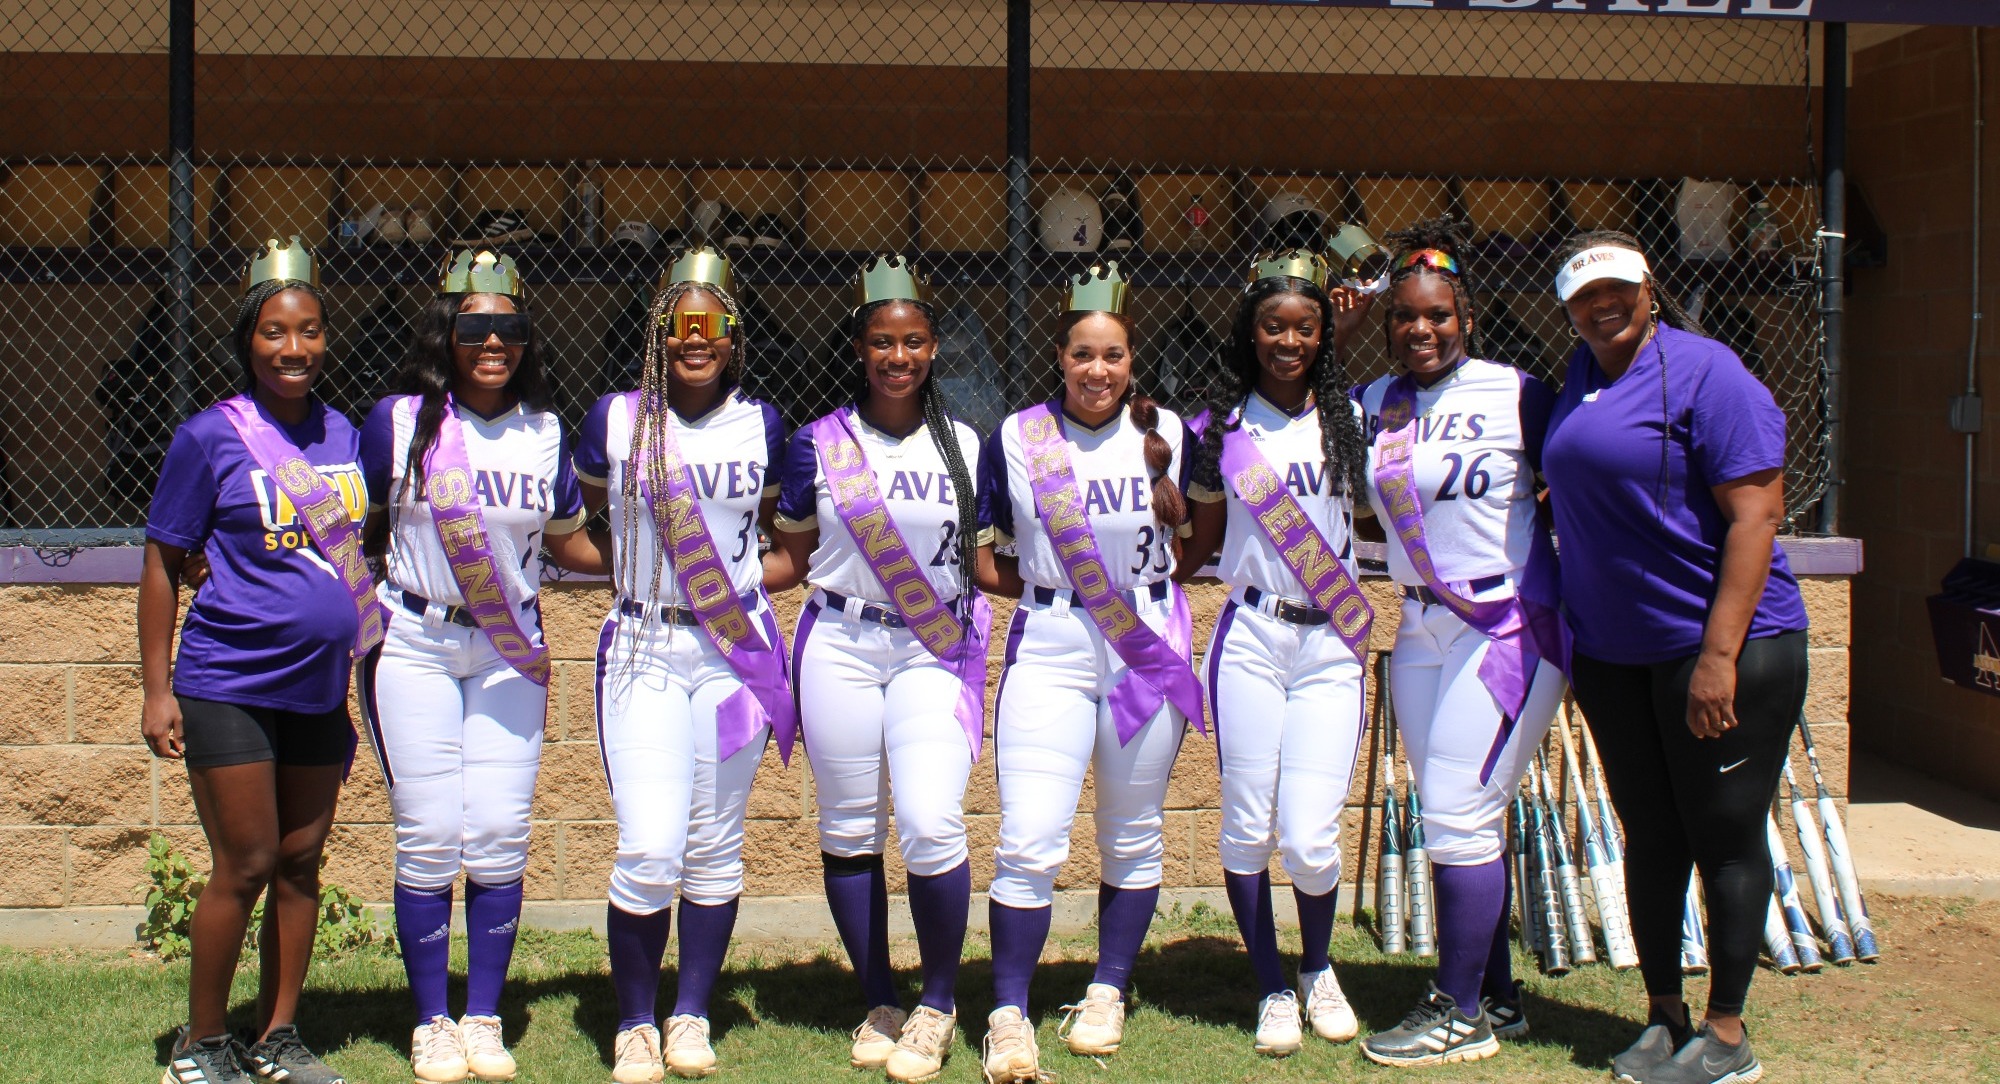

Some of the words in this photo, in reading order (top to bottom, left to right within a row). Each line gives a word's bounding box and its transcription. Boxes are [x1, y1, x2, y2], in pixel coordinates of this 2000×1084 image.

[1073, 225, 1087, 246] 4
[1571, 252, 1616, 273] BRAVES
[475, 469, 549, 512] AVES
[872, 470, 956, 506] AVE
[1435, 452, 1492, 502] 26
[276, 457, 383, 652] SENIO
[825, 439, 964, 657] SENIOR
[1022, 414, 1137, 643] SENIOR
[1383, 876, 1400, 947] CRBN
[1408, 860, 1429, 937] CRBN
[1540, 869, 1567, 950] CRBN
